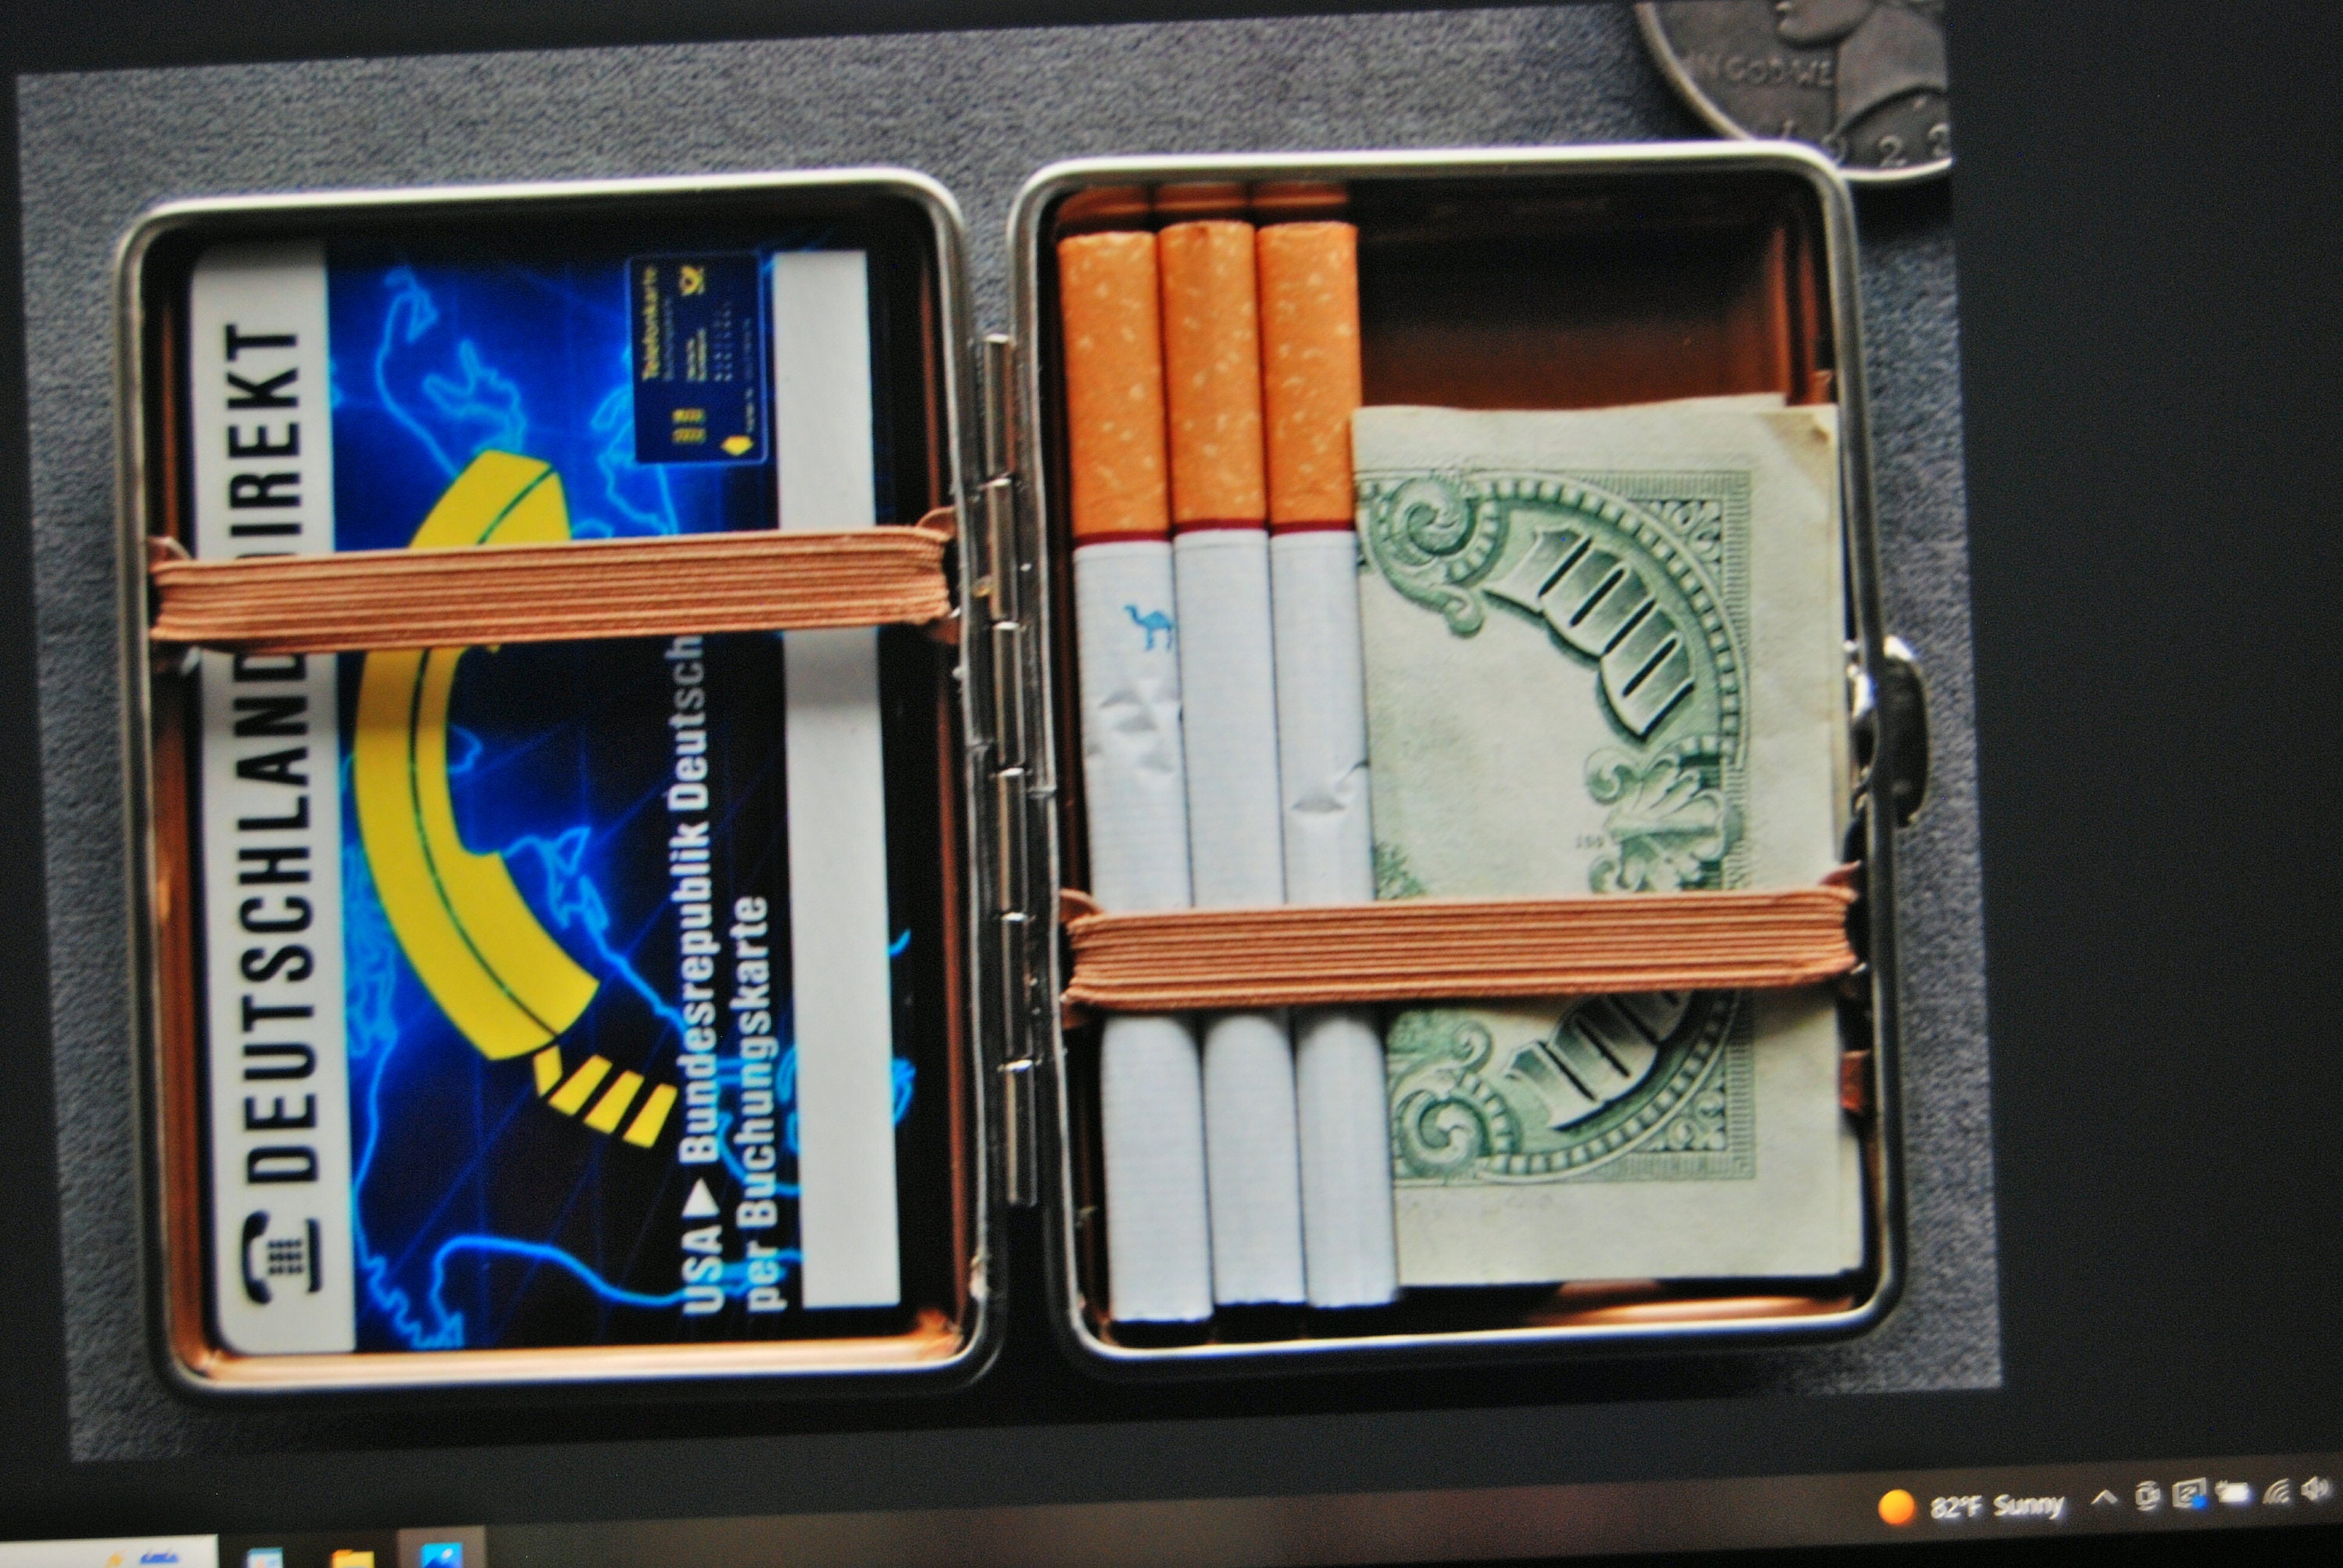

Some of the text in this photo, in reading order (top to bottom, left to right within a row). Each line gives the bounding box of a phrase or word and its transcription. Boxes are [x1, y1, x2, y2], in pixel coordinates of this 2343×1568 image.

[226, 323, 319, 1184] DEUTSCHLAND IREKT
[669, 821, 721, 1164] Bundesrepublik
[729, 895, 786, 1313] per Buchungskarte
[682, 1225, 727, 1314] USA
[1931, 1493, 2066, 1520] 82°F Sunny
